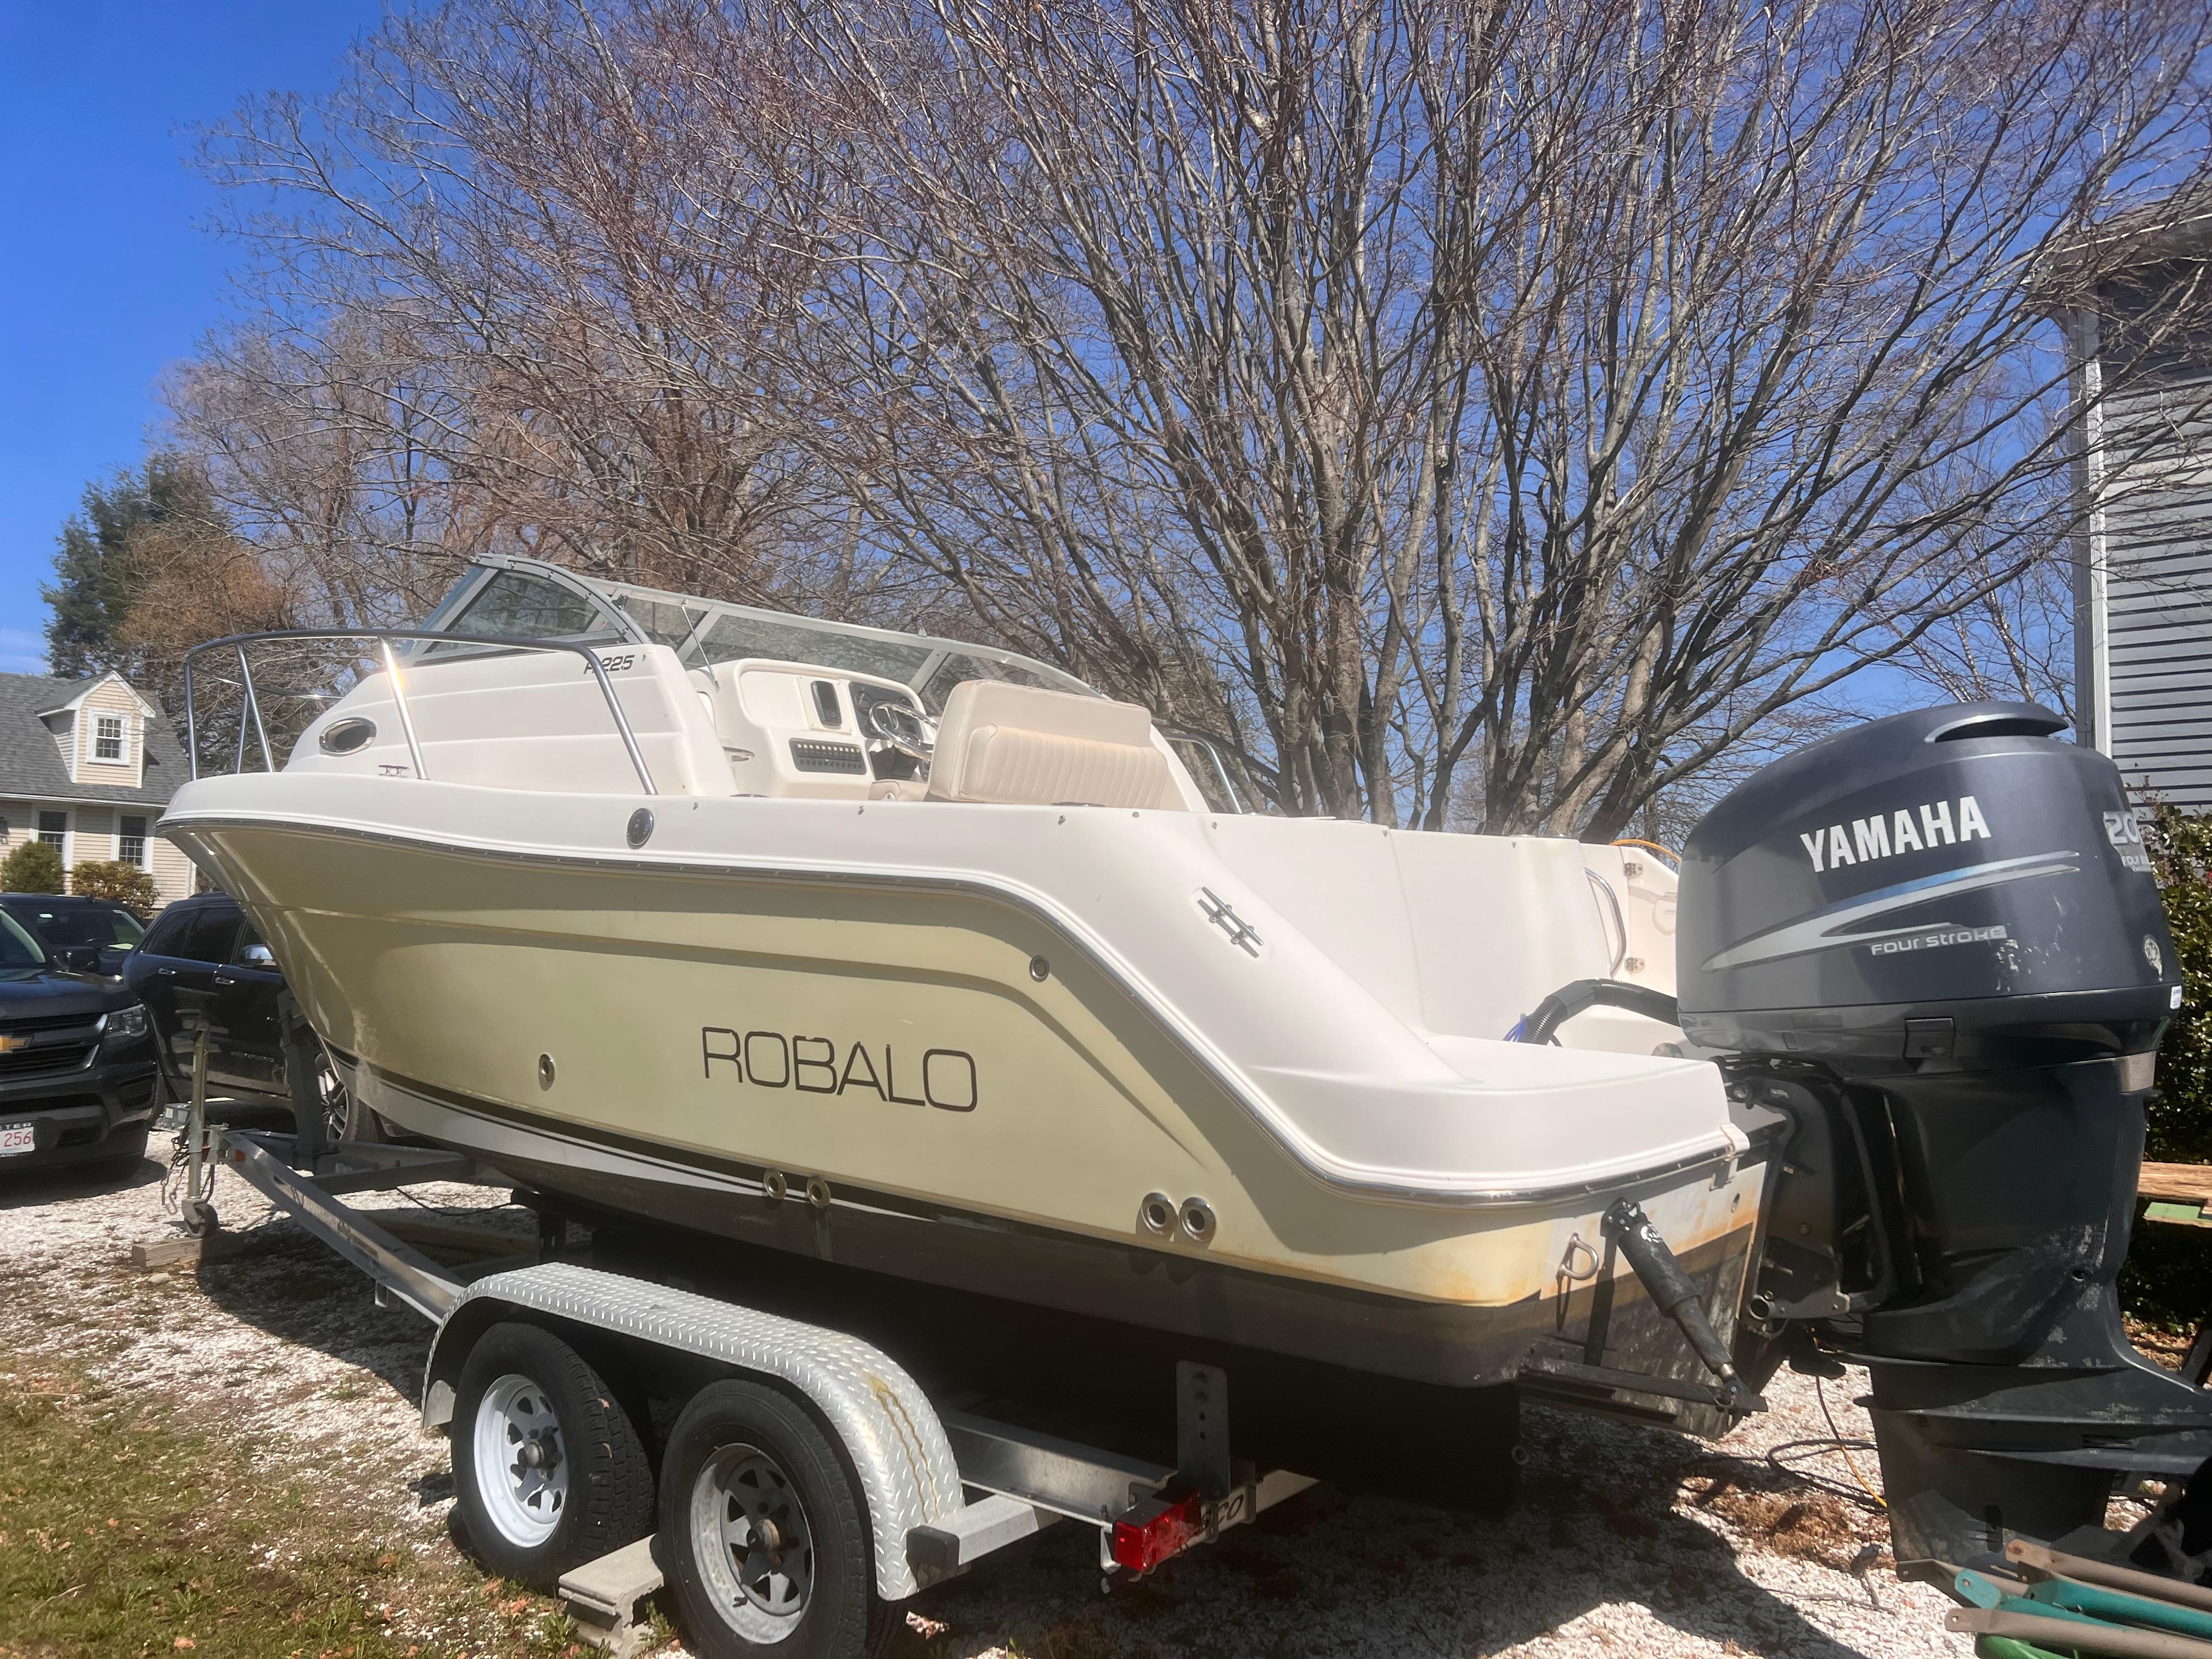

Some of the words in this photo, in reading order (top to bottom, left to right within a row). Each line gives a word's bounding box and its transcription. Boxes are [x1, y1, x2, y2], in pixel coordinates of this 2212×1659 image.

[1799, 795, 1992, 872] YAMAHA
[702, 1026, 978, 1113] ROBALO
[4, 1131, 31, 1147] 256
